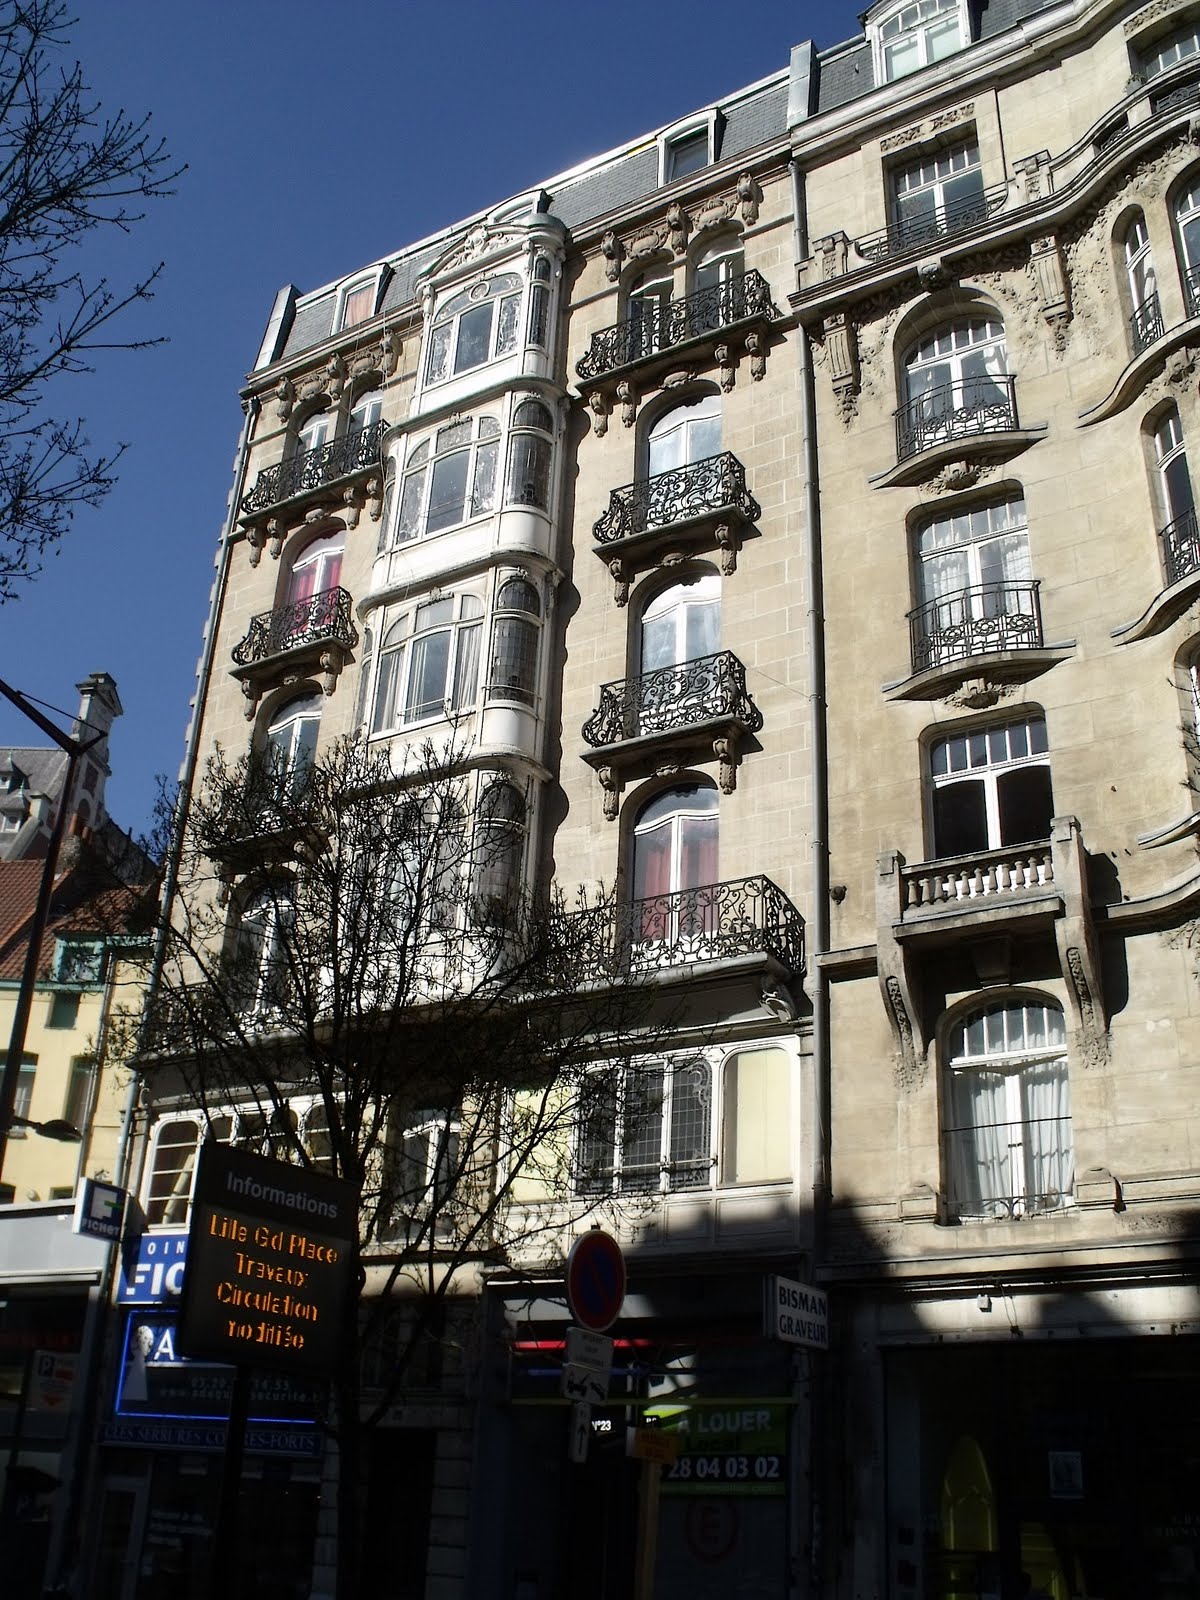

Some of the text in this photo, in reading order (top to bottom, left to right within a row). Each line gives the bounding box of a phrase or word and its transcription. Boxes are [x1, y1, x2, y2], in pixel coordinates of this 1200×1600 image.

[226, 1170, 338, 1219] Informations
[208, 1214, 338, 1264] Lille Gd Place
[125, 1261, 186, 1296] FIC
[216, 1282, 318, 1322] Circulation
[779, 1286, 827, 1317] BISMAN
[779, 1314, 827, 1345] GRAVEUR
[697, 1409, 772, 1433] LOUER
[695, 1457, 721, 1479] 04
[725, 1456, 750, 1479] 03
[754, 1456, 780, 1479] 02
